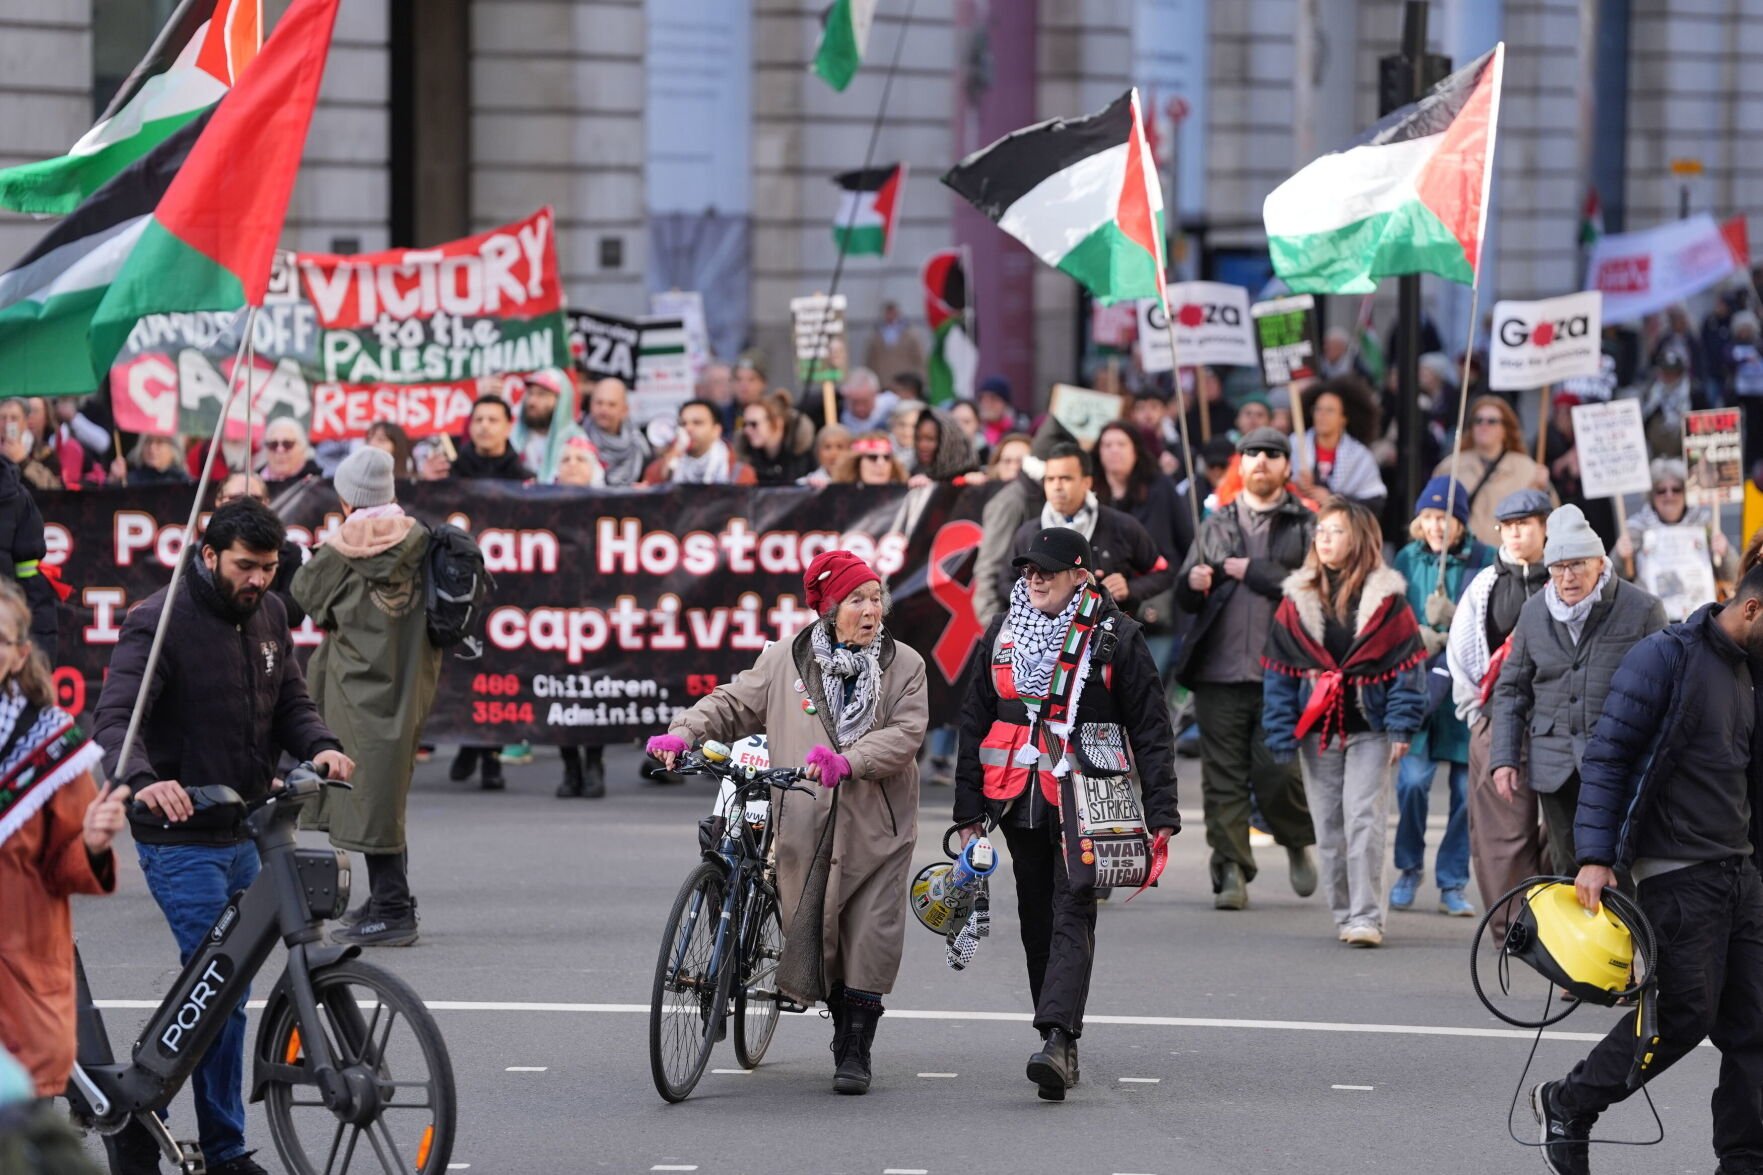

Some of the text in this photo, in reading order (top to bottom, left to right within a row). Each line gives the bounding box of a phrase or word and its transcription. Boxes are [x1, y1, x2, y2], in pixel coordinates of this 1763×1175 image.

[299, 216, 549, 324] VICTORY
[253, 305, 315, 353] OFF
[324, 328, 555, 385] PALESTINIAN
[373, 309, 501, 349] to the
[128, 348, 311, 432] GAZA
[313, 373, 526, 435] RESISTAC
[487, 590, 819, 664] captivit
[472, 701, 535, 724] 3544
[1090, 800, 1140, 821] STRIKERS
[1096, 842, 1144, 857] WAR
[161, 960, 225, 1052] PORT
